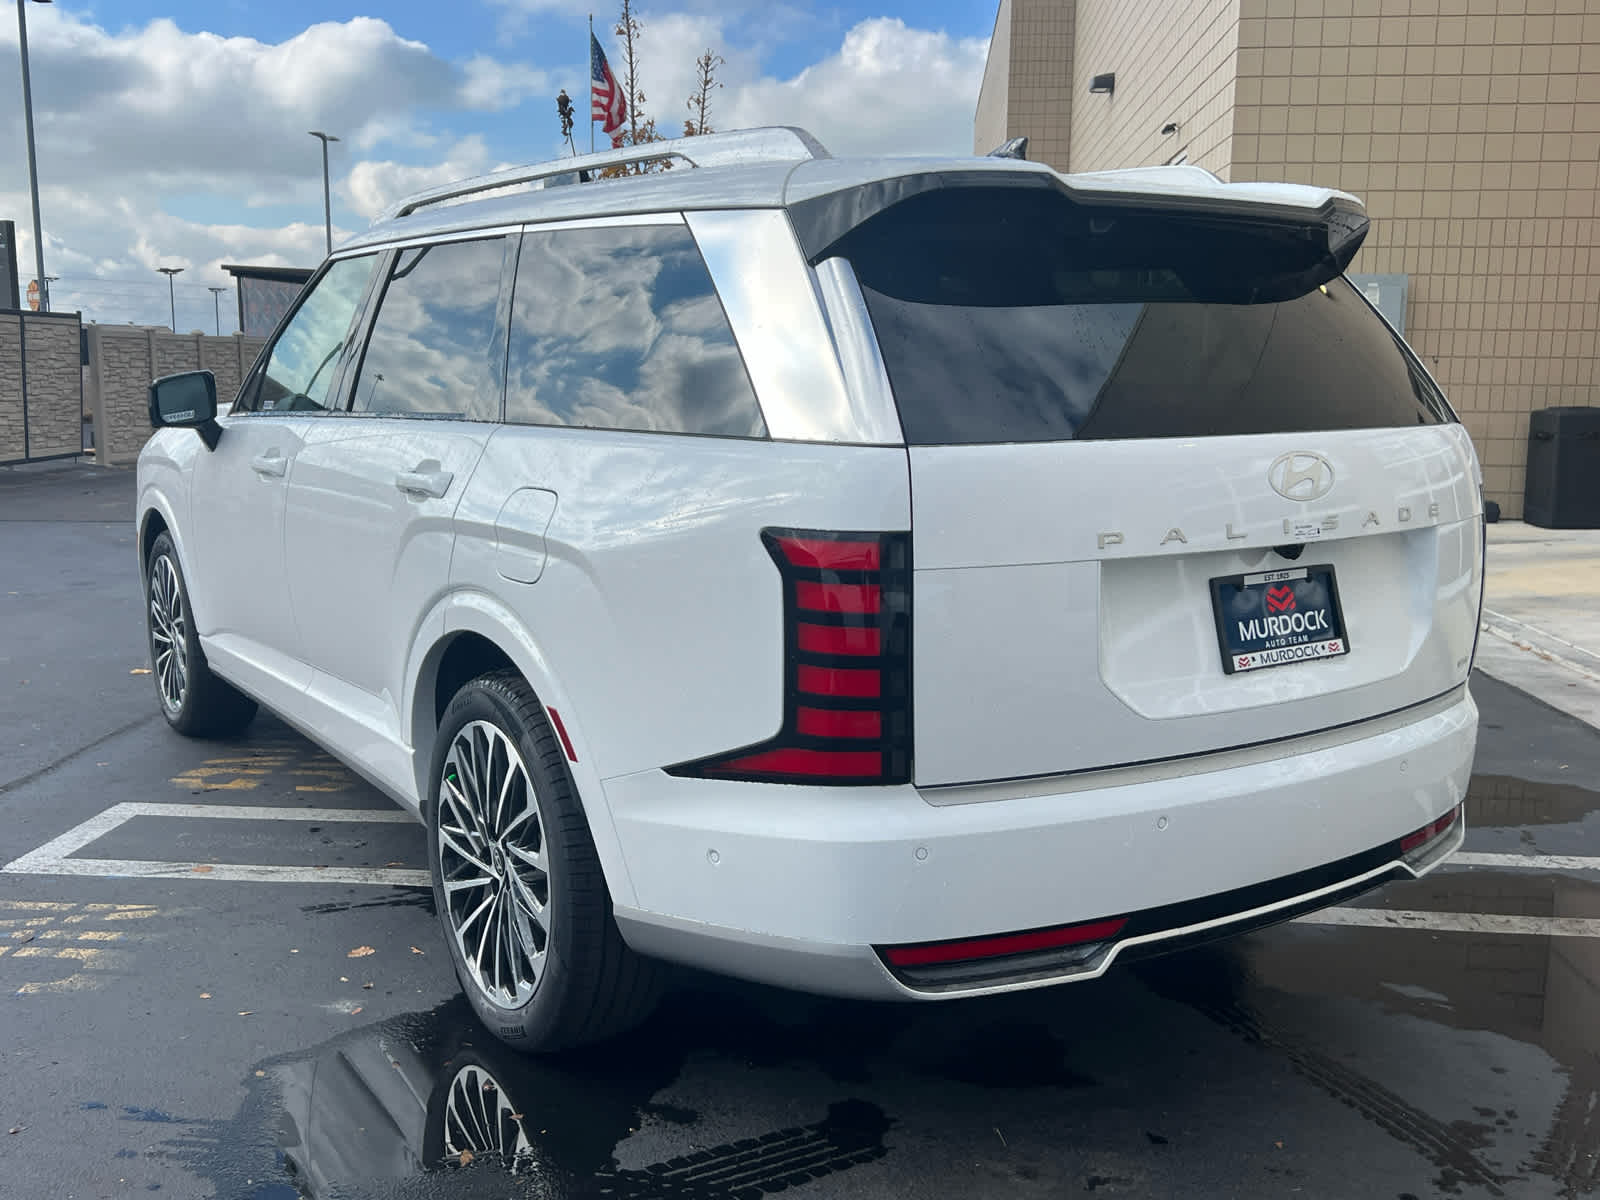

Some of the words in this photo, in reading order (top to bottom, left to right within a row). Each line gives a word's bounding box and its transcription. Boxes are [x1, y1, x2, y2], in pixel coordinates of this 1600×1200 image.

[1097, 503, 1439, 550] PALISADE
[1238, 609, 1329, 642] MURDOCK
[1265, 639, 1286, 649] AUTO
[1288, 634, 1309, 645] TEAM
[1260, 645, 1319, 665] MURDOCK
